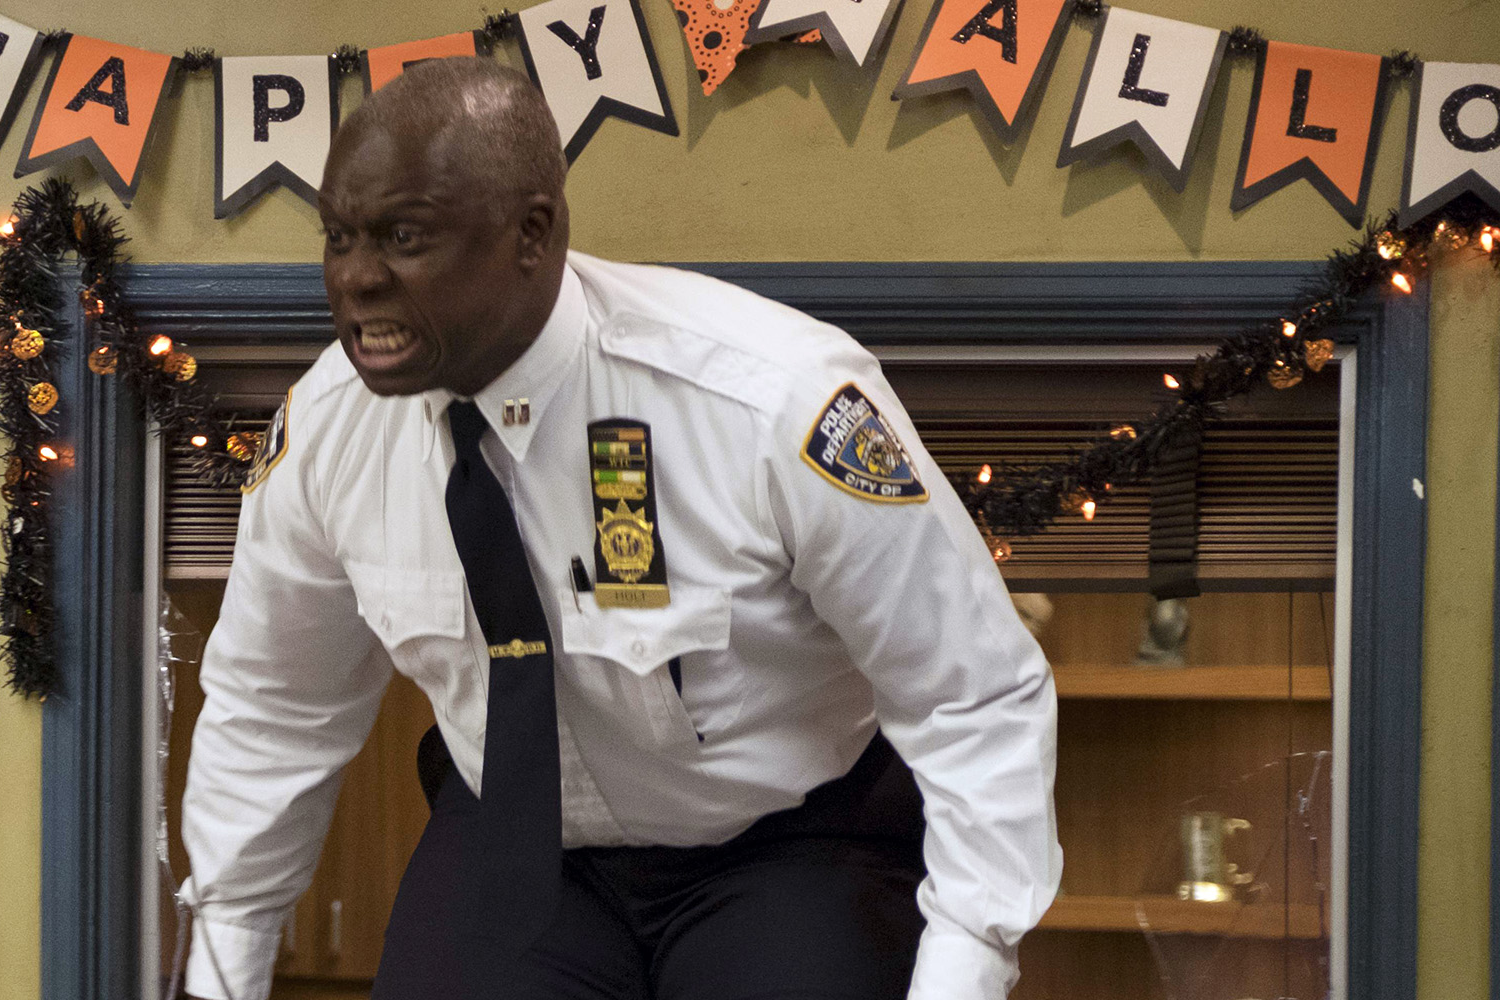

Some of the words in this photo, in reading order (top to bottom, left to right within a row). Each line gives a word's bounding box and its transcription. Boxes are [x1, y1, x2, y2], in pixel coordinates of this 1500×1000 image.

[854, 0, 1500, 152] ALLO
[846, 474, 877, 493] CITY
[881, 485, 902, 497] OF
